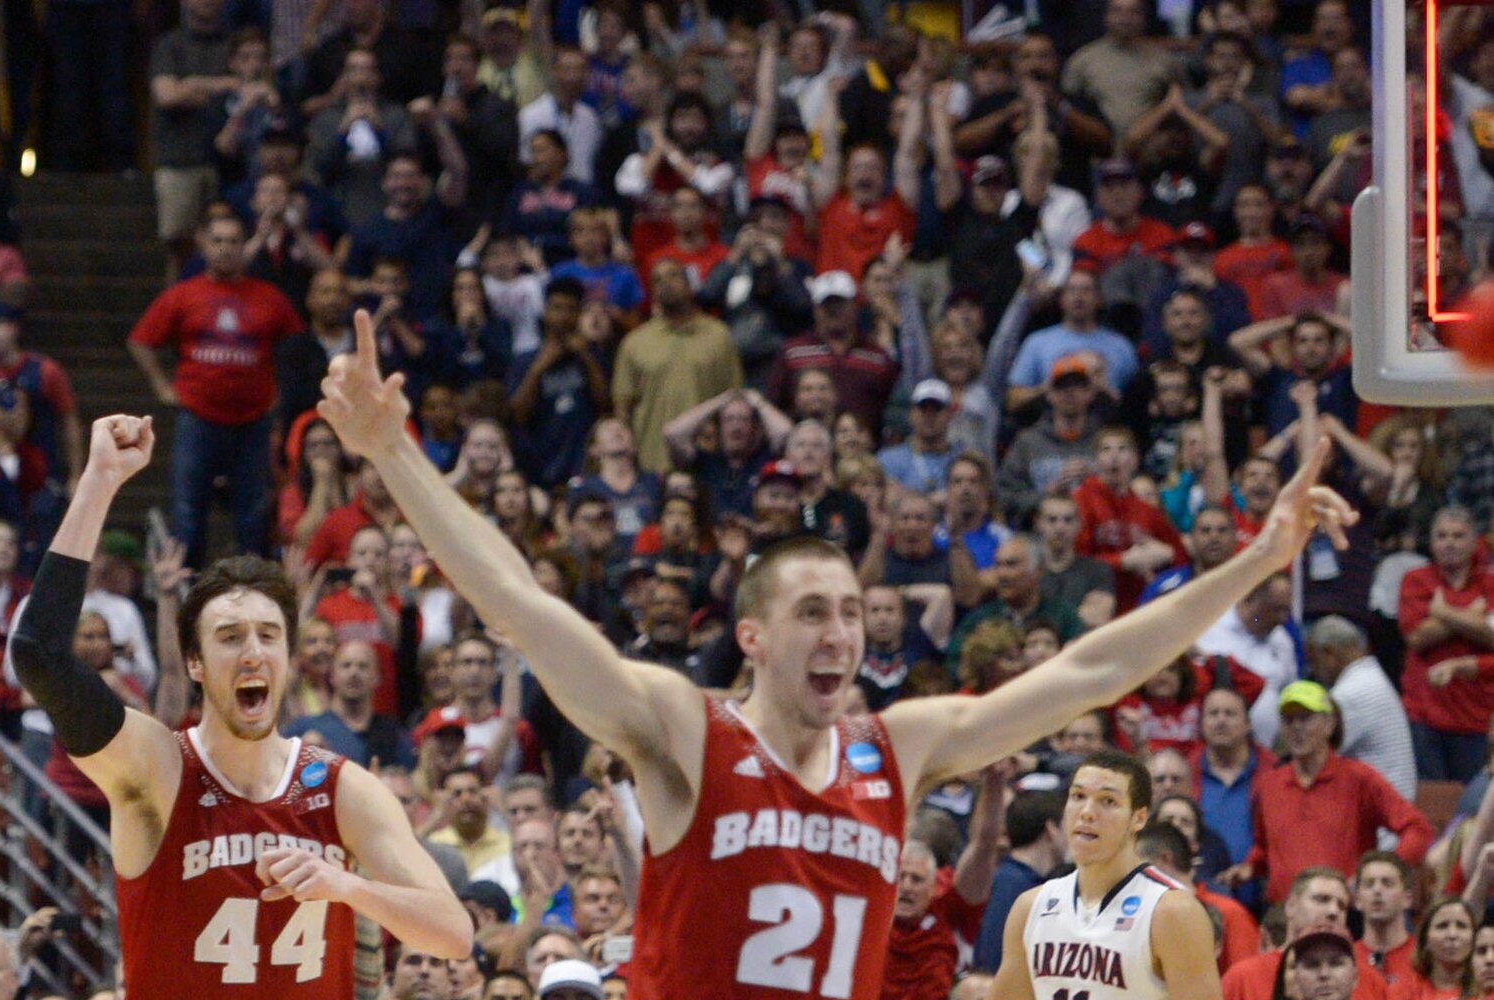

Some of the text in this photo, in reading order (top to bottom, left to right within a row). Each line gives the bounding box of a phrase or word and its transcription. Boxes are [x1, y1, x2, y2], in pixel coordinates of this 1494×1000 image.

[710, 808, 900, 885] BADGERS
[193, 897, 330, 984] 44
[736, 883, 867, 1000] 21
